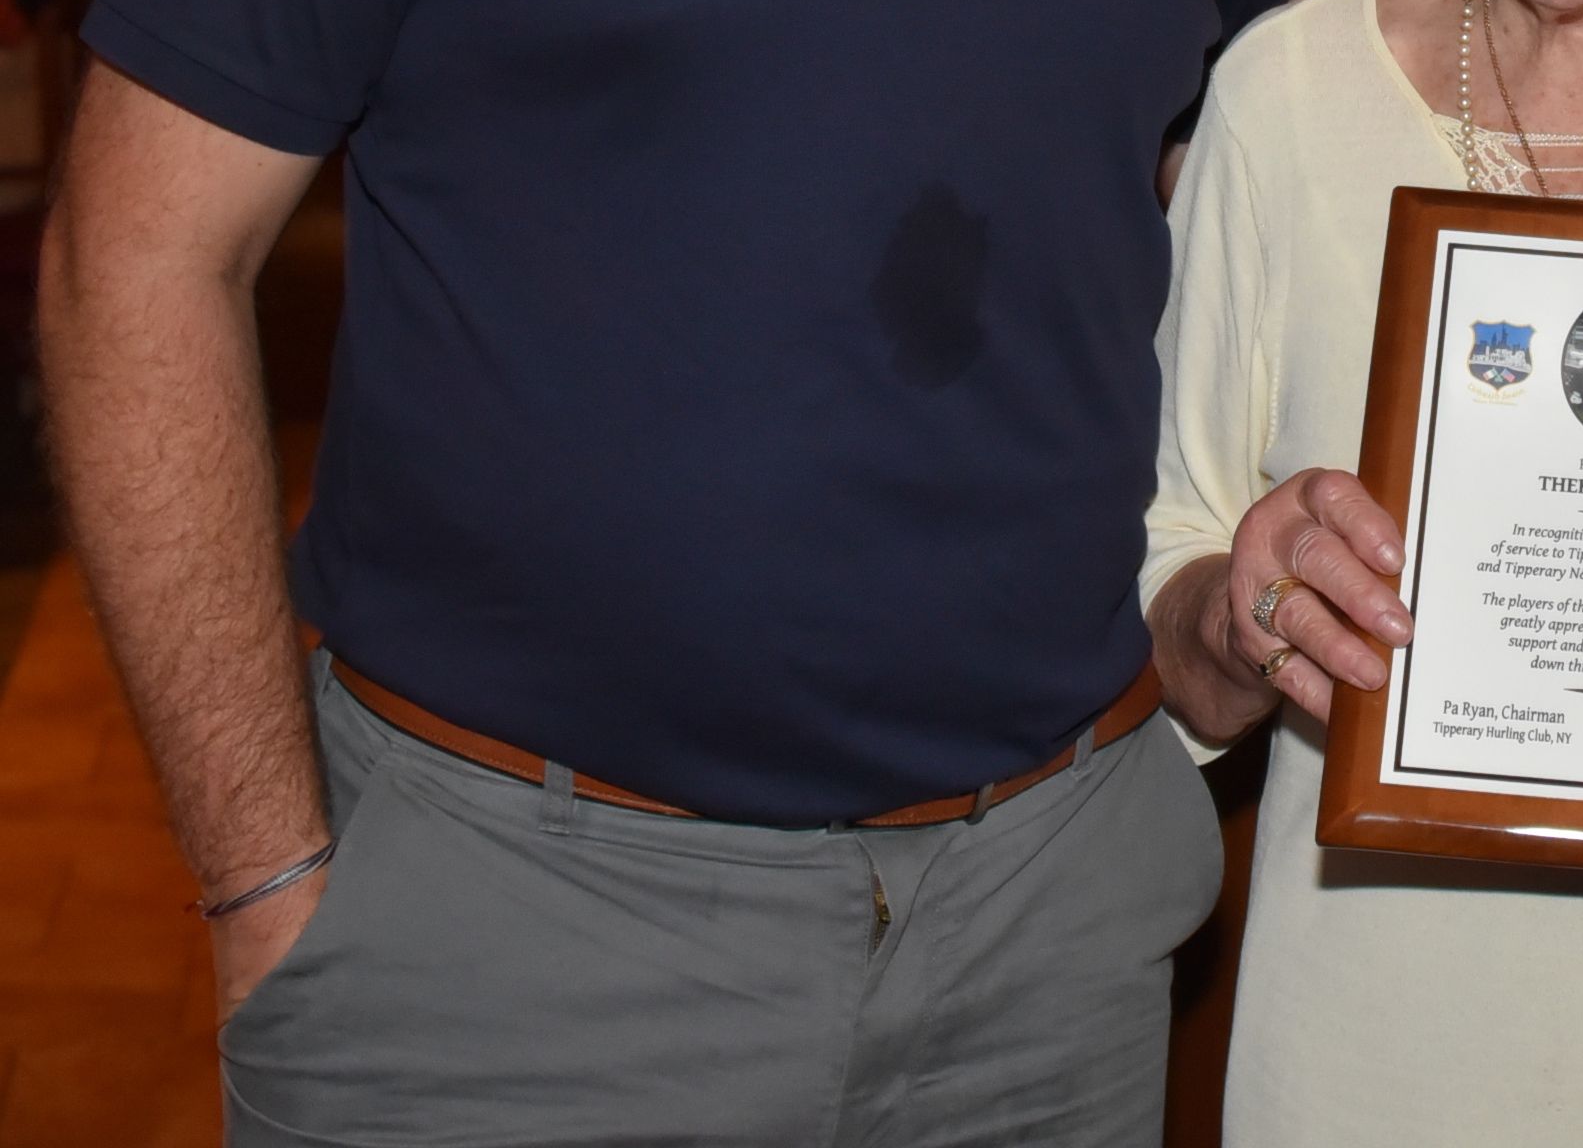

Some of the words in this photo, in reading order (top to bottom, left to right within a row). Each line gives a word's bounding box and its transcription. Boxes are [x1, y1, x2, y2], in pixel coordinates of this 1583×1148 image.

[1513, 524, 1525, 536] In
[1491, 540, 1506, 556] of
[1506, 544, 1549, 557] service
[1552, 548, 1564, 558] to
[1477, 559, 1501, 572] and
[1505, 562, 1566, 582] Tipperary
[1483, 591, 1505, 606] The
[1507, 594, 1554, 612] players
[1557, 598, 1572, 614] of
[1500, 615, 1545, 633] greatly
[1508, 637, 1557, 652] support
[1530, 655, 1564, 671] down
[1443, 700, 1458, 715] Pa
[1462, 702, 1498, 721] Ryan,
[1501, 704, 1565, 724] Chairman
[1433, 721, 1484, 740] Tipperary
[1486, 726, 1525, 744] Hurling
[1528, 729, 1553, 744] Club,
[1556, 732, 1572, 744] NY
